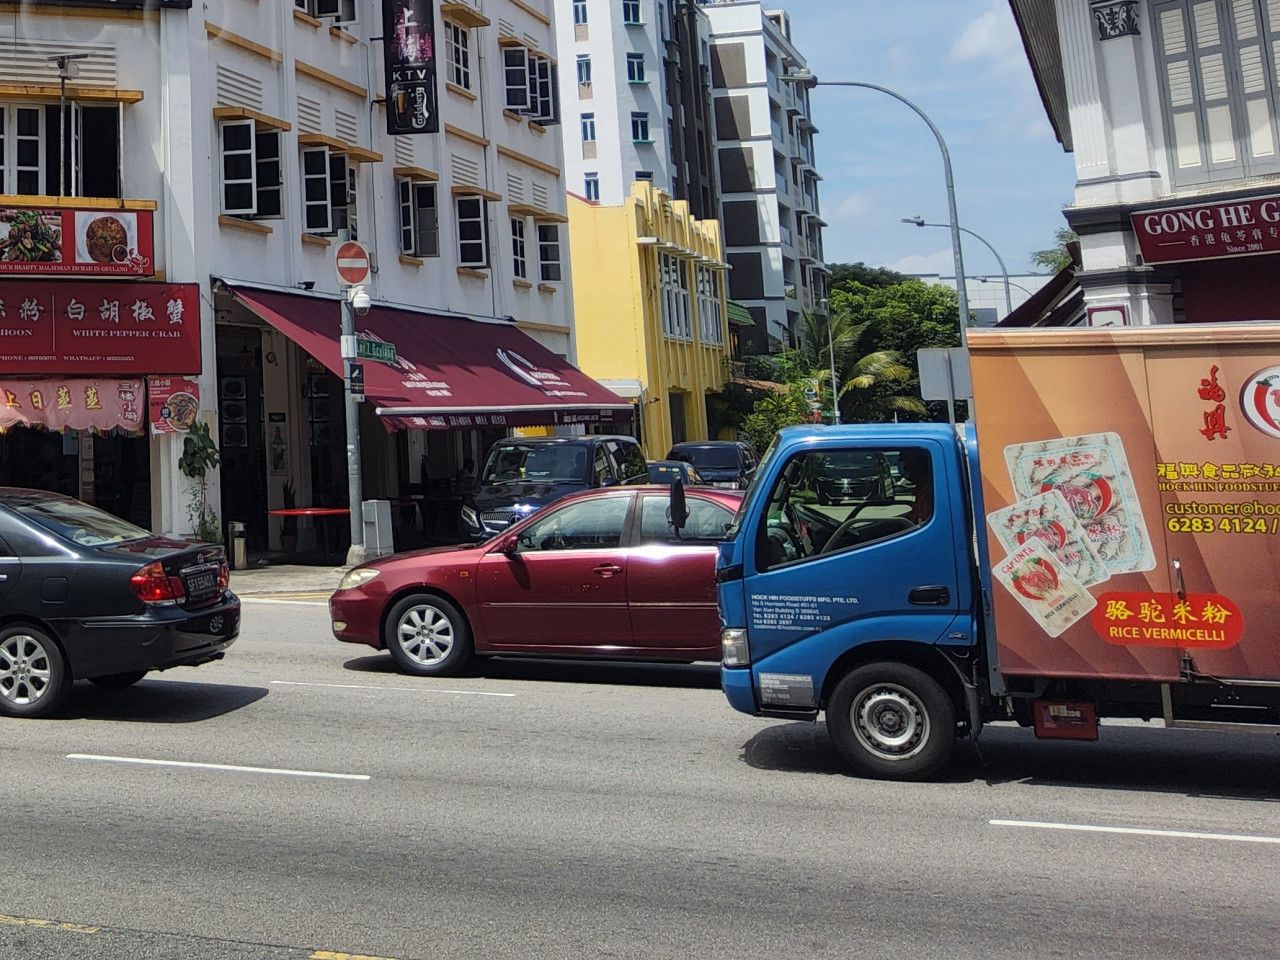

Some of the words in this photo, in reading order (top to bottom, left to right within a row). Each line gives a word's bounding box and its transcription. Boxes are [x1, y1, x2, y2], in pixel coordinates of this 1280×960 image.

[392, 69, 427, 82] KTV
[412, 86, 426, 129] Carlsberg
[1144, 209, 1214, 235] GONG
[1217, 204, 1256, 227] HE
[1260, 201, 1280, 222] G
[1226, 245, 1246, 254] Since
[1247, 242, 1264, 251] 2001
[38, 264, 71, 272] MALAYSIAN
[65, 297, 186, 326] 白胡椒蟹
[72, 329, 108, 337] WHITE
[109, 330, 150, 338] PEPPER
[152, 330, 181, 338] CRAB
[1158, 482, 1193, 492] HOCK
[1194, 482, 1217, 492] HIN
[1167, 517, 1215, 533] 6283
[1218, 518, 1268, 533] 4124
[1105, 598, 1233, 625] 骆驼米粉
[1109, 626, 1142, 639] RICE
[1143, 627, 1226, 642] VERMICELLI
